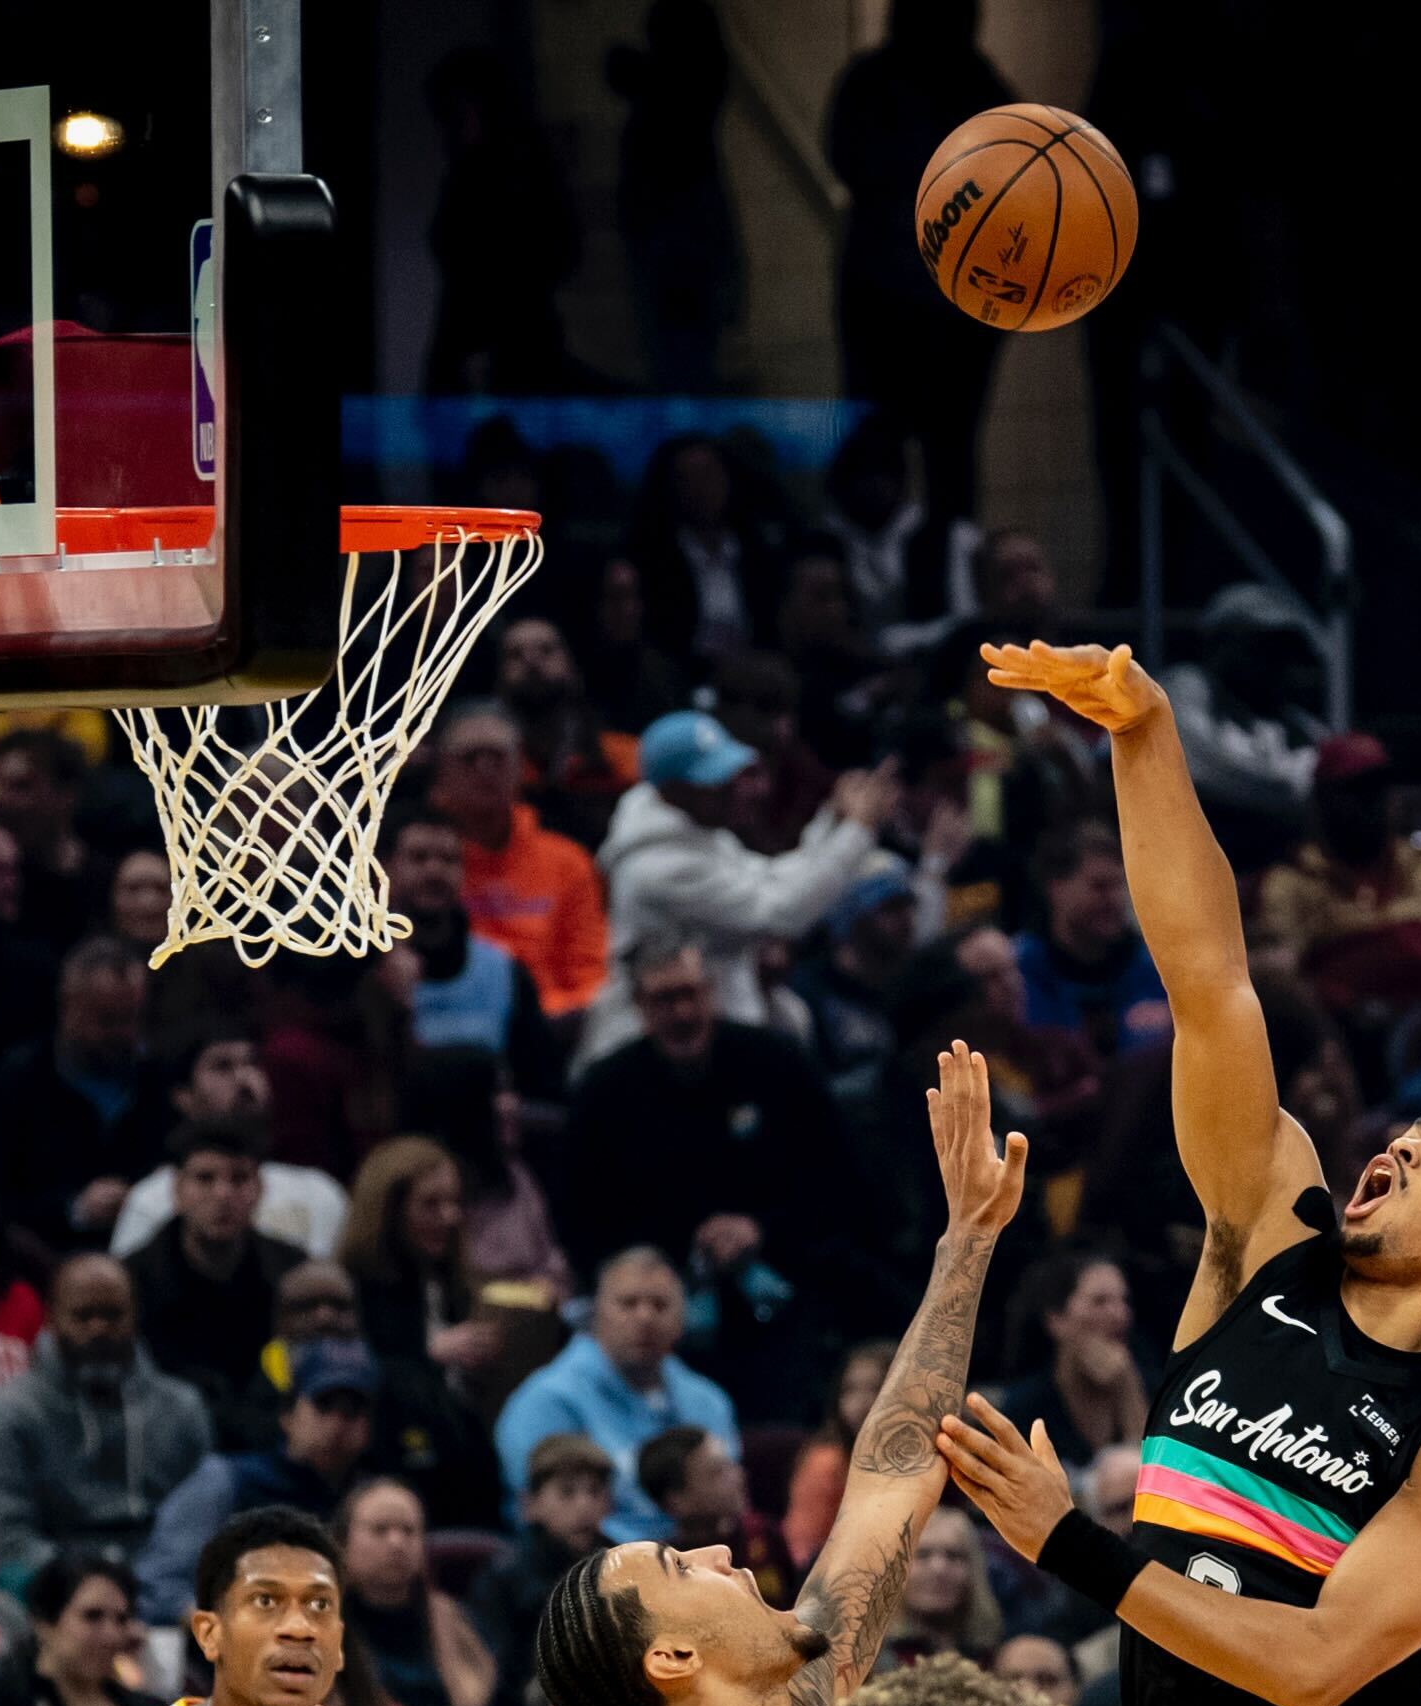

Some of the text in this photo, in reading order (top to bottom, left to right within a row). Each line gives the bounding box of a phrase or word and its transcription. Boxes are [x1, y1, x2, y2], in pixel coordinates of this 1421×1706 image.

[1169, 1369, 1375, 1495] San Antonio
[1359, 1404, 1401, 1447] LEDGER
